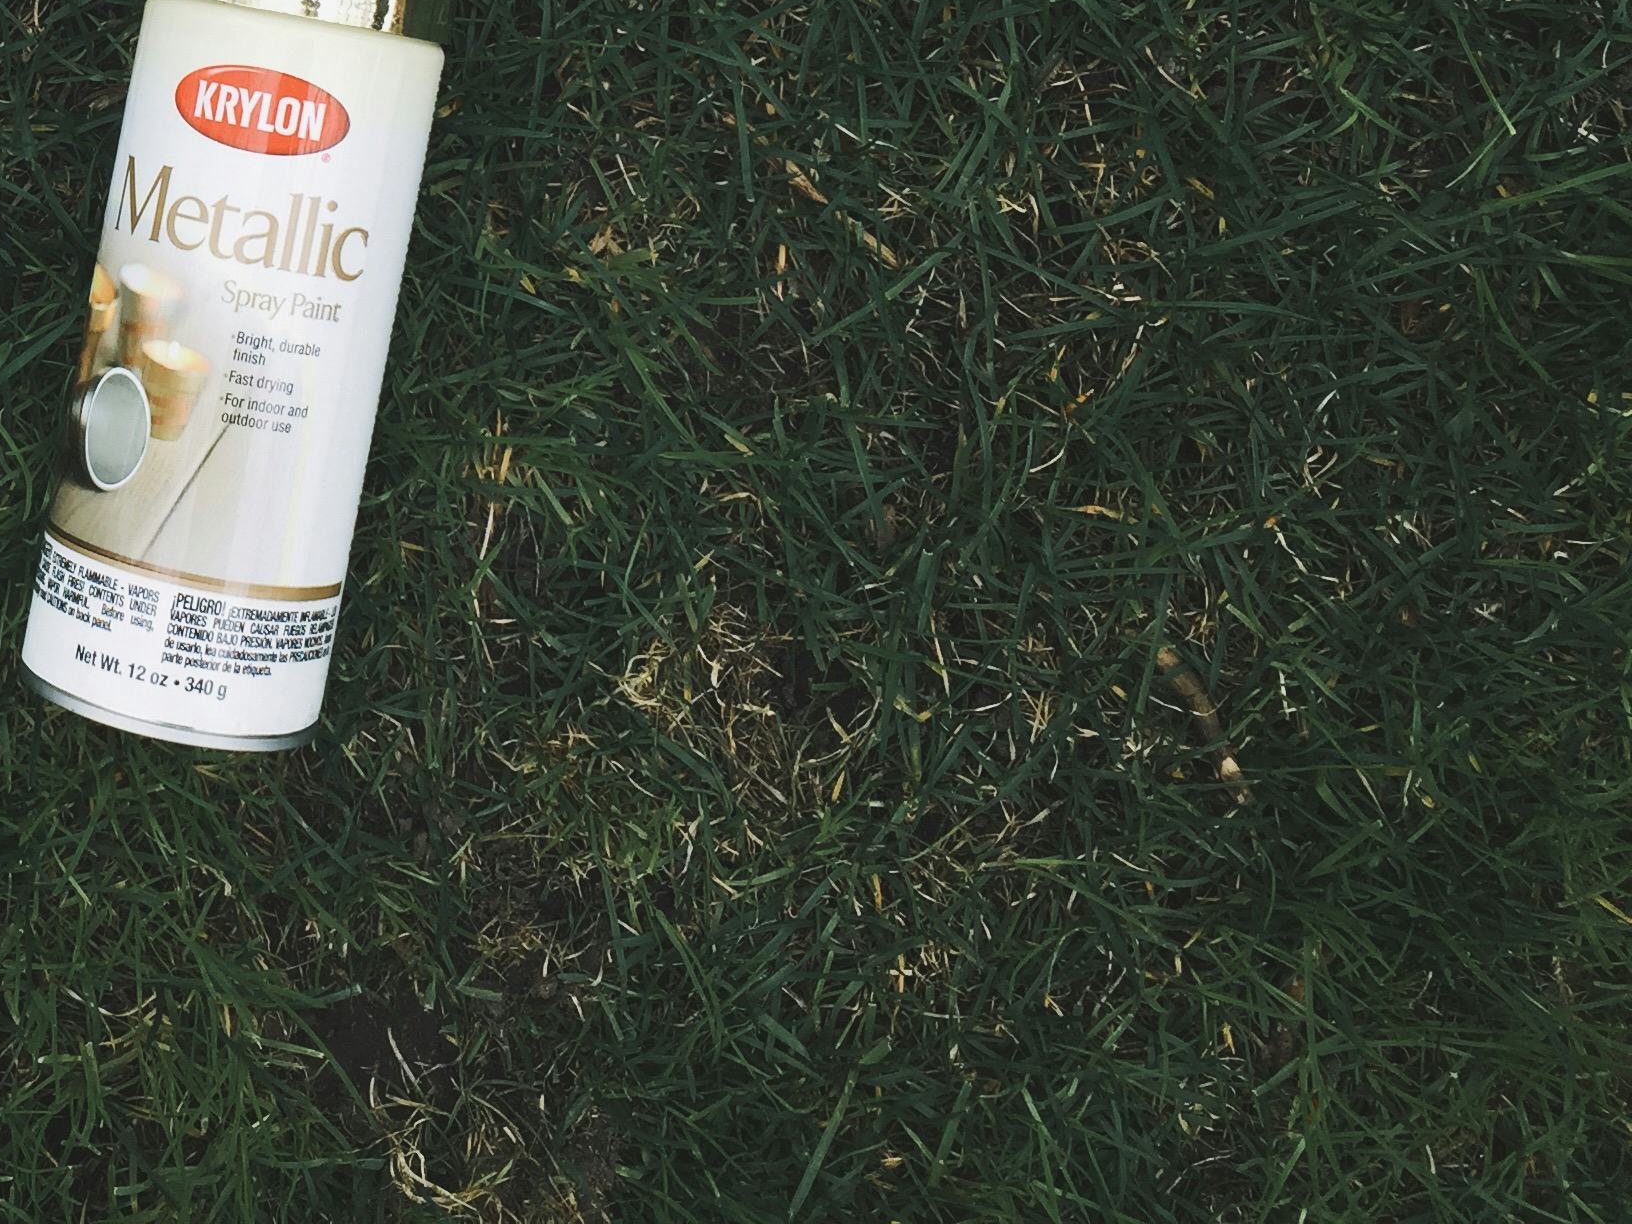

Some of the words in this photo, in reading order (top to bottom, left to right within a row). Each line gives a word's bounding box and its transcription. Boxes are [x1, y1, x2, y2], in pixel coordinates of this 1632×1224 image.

[194, 80, 327, 141] KRYLON
[115, 155, 369, 281] Metallic
[221, 280, 286, 320] Spray
[290, 292, 342, 322] Paint
[233, 348, 266, 365] finish
[236, 331, 275, 352] Bright,
[279, 339, 321, 357] durable
[229, 370, 253, 387] Fast
[257, 376, 294, 395] drying
[224, 392, 245, 408] For
[247, 396, 285, 416] indoor
[288, 405, 308, 418] and
[221, 412, 268, 429] outdoor
[272, 421, 292, 433] use
[88, 584, 125, 607] CONTENTS
[129, 598, 157, 617] UNDER
[128, 583, 160, 603] VAPORS
[101, 603, 125, 622] Before
[170, 608, 208, 627] VAPORES
[213, 618, 246, 633] PUEDEN
[250, 622, 279, 636] CAUSAR
[164, 637, 174, 649] de
[205, 644, 216, 656] lea
[166, 623, 214, 642] CONTENIDO
[216, 632, 239, 646] BAJO
[75, 644, 97, 666] Net
[100, 654, 122, 675] Wt.
[128, 663, 146, 681] 12
[150, 672, 168, 687] oz
[185, 676, 213, 695] 340
[217, 684, 227, 700] g
[161, 651, 183, 664] parte
[184, 655, 221, 671] posterior
[221, 661, 232, 672] de
[233, 662, 241, 674] la
